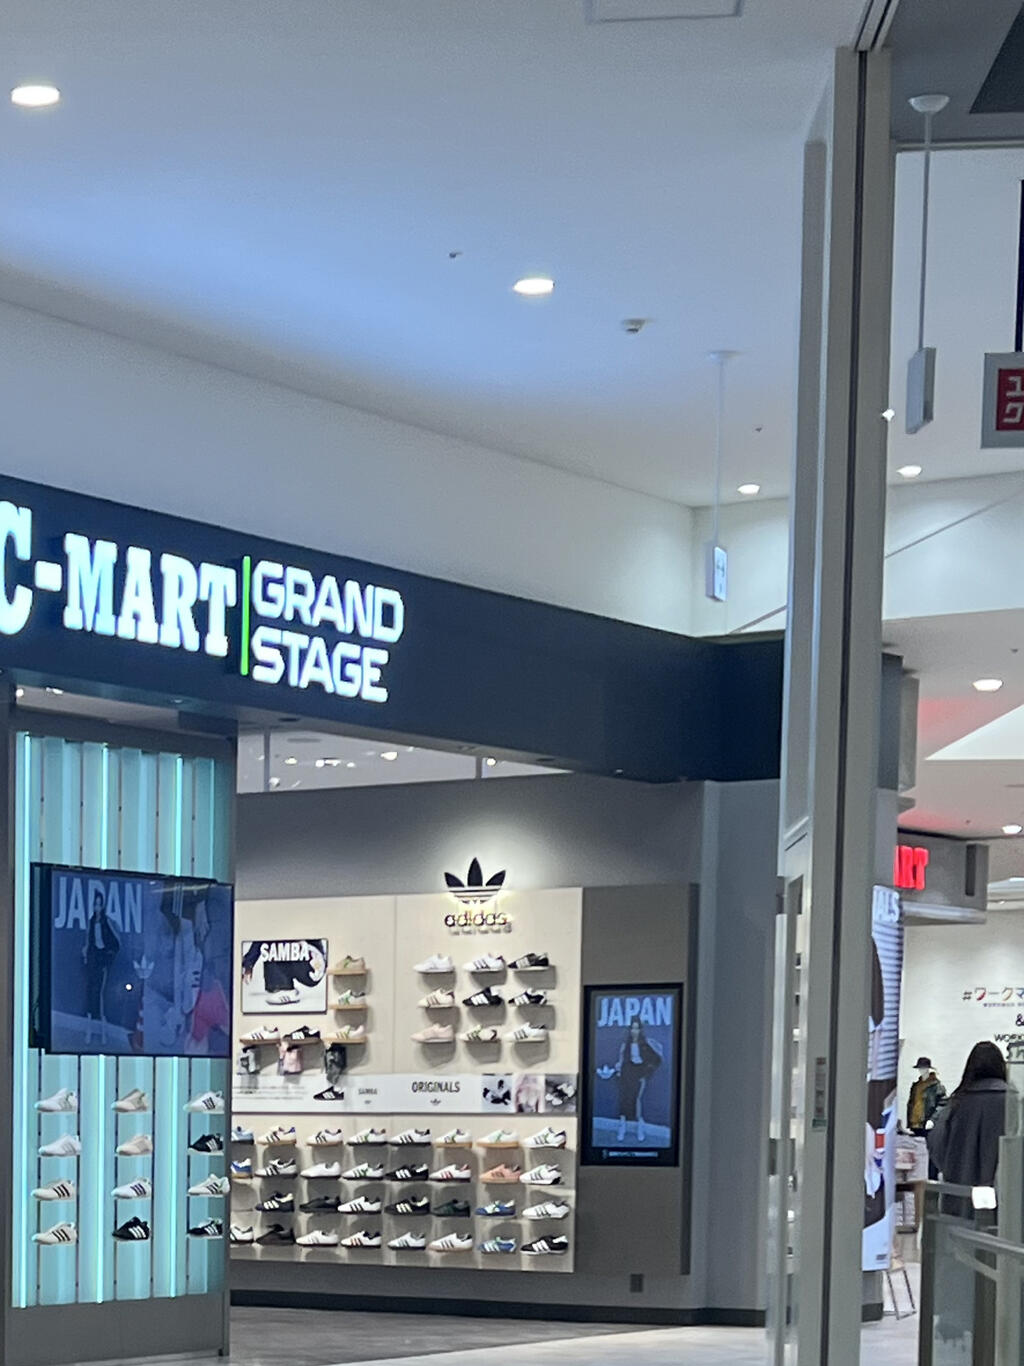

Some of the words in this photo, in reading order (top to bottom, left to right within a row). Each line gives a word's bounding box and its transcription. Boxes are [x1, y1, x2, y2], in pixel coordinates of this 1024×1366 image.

[252, 559, 404, 643] GRAND
[252, 626, 388, 702] STAGE
[54, 876, 142, 934] JAPAN
[444, 910, 508, 928] adidas
[260, 942, 311, 961] SAMBA
[597, 997, 673, 1028] JAPAN
[412, 1081, 461, 1093] ORIGINALS
